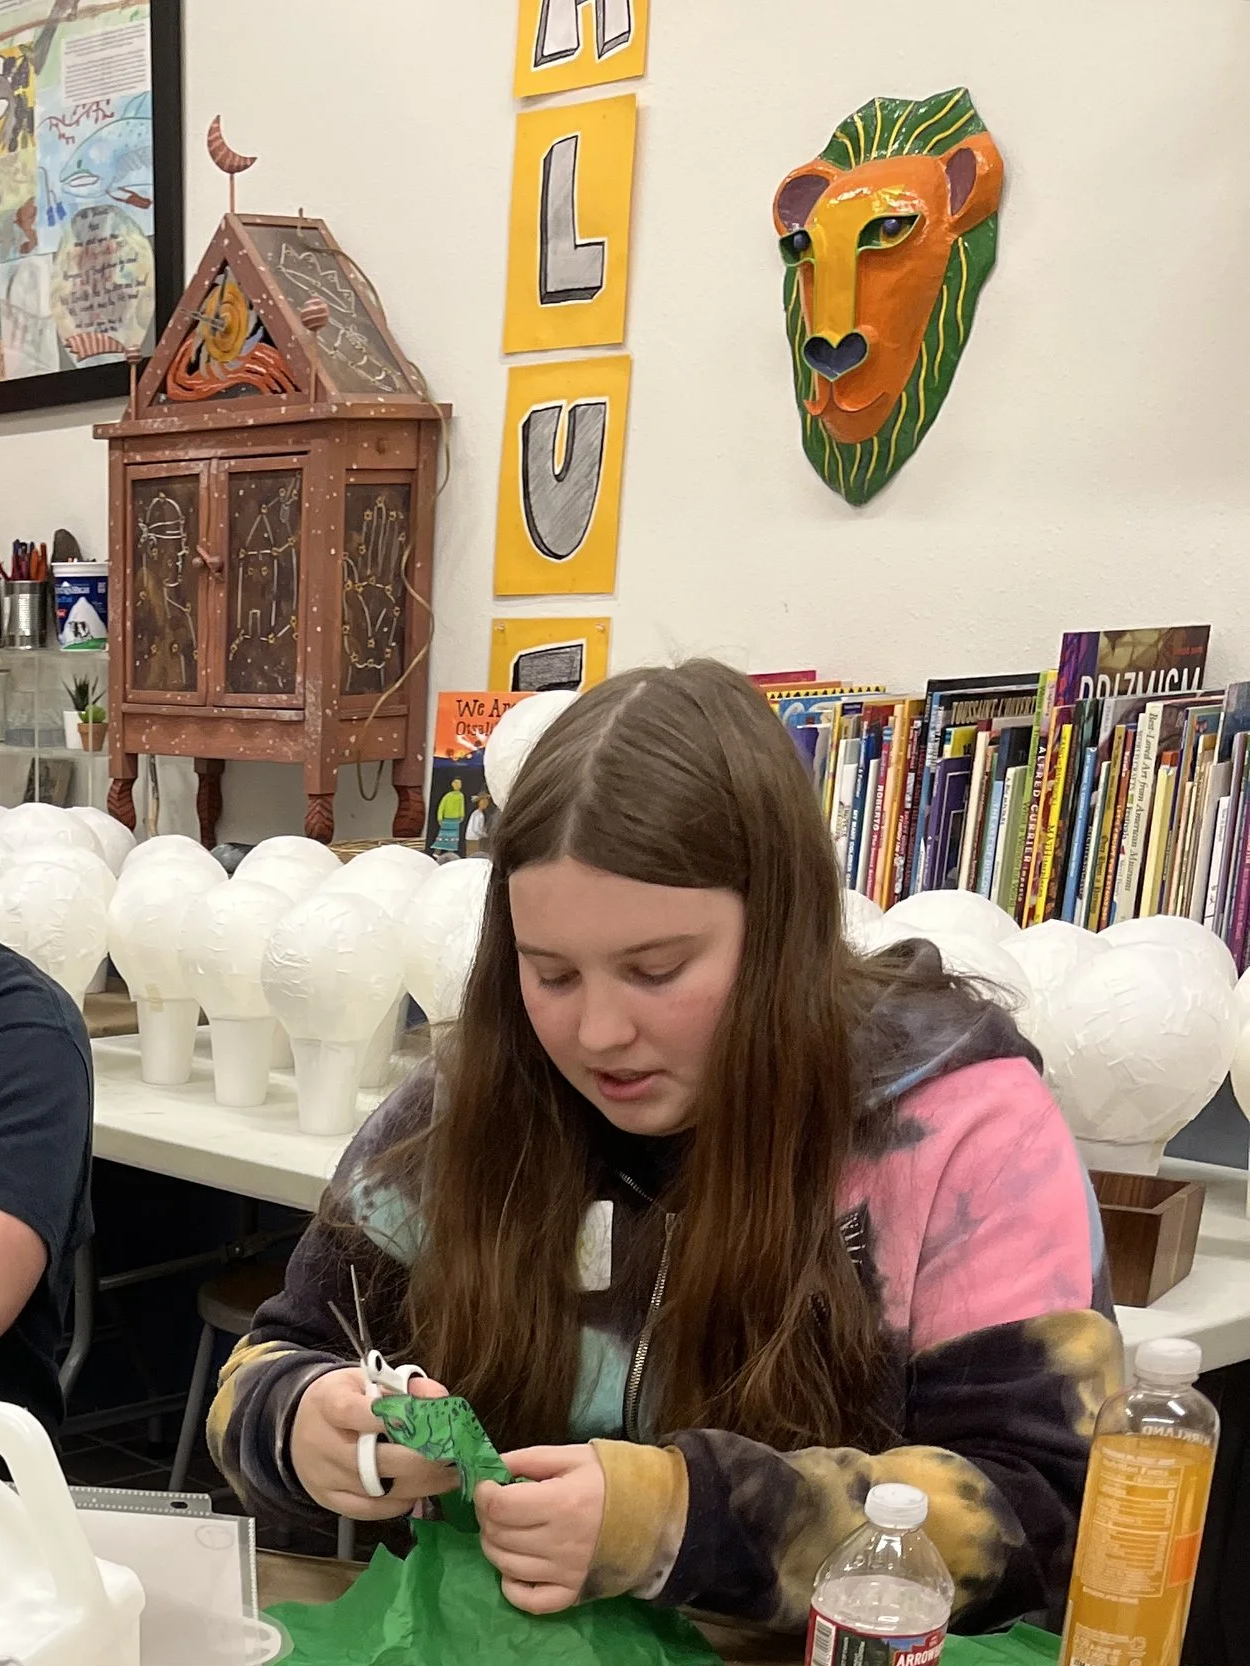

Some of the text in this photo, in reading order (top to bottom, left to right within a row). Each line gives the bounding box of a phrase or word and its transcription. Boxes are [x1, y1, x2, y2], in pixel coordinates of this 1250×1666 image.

[456, 698, 518, 718] We Ar
[1032, 745, 1047, 797] ALFRED
[1136, 781, 1147, 801] from
[1140, 762, 1150, 778] Art
[872, 784, 884, 831] ROBERTO
[1130, 804, 1144, 847] American
[1023, 804, 1039, 863] CURRIER
[1125, 849, 1138, 892] Museums
